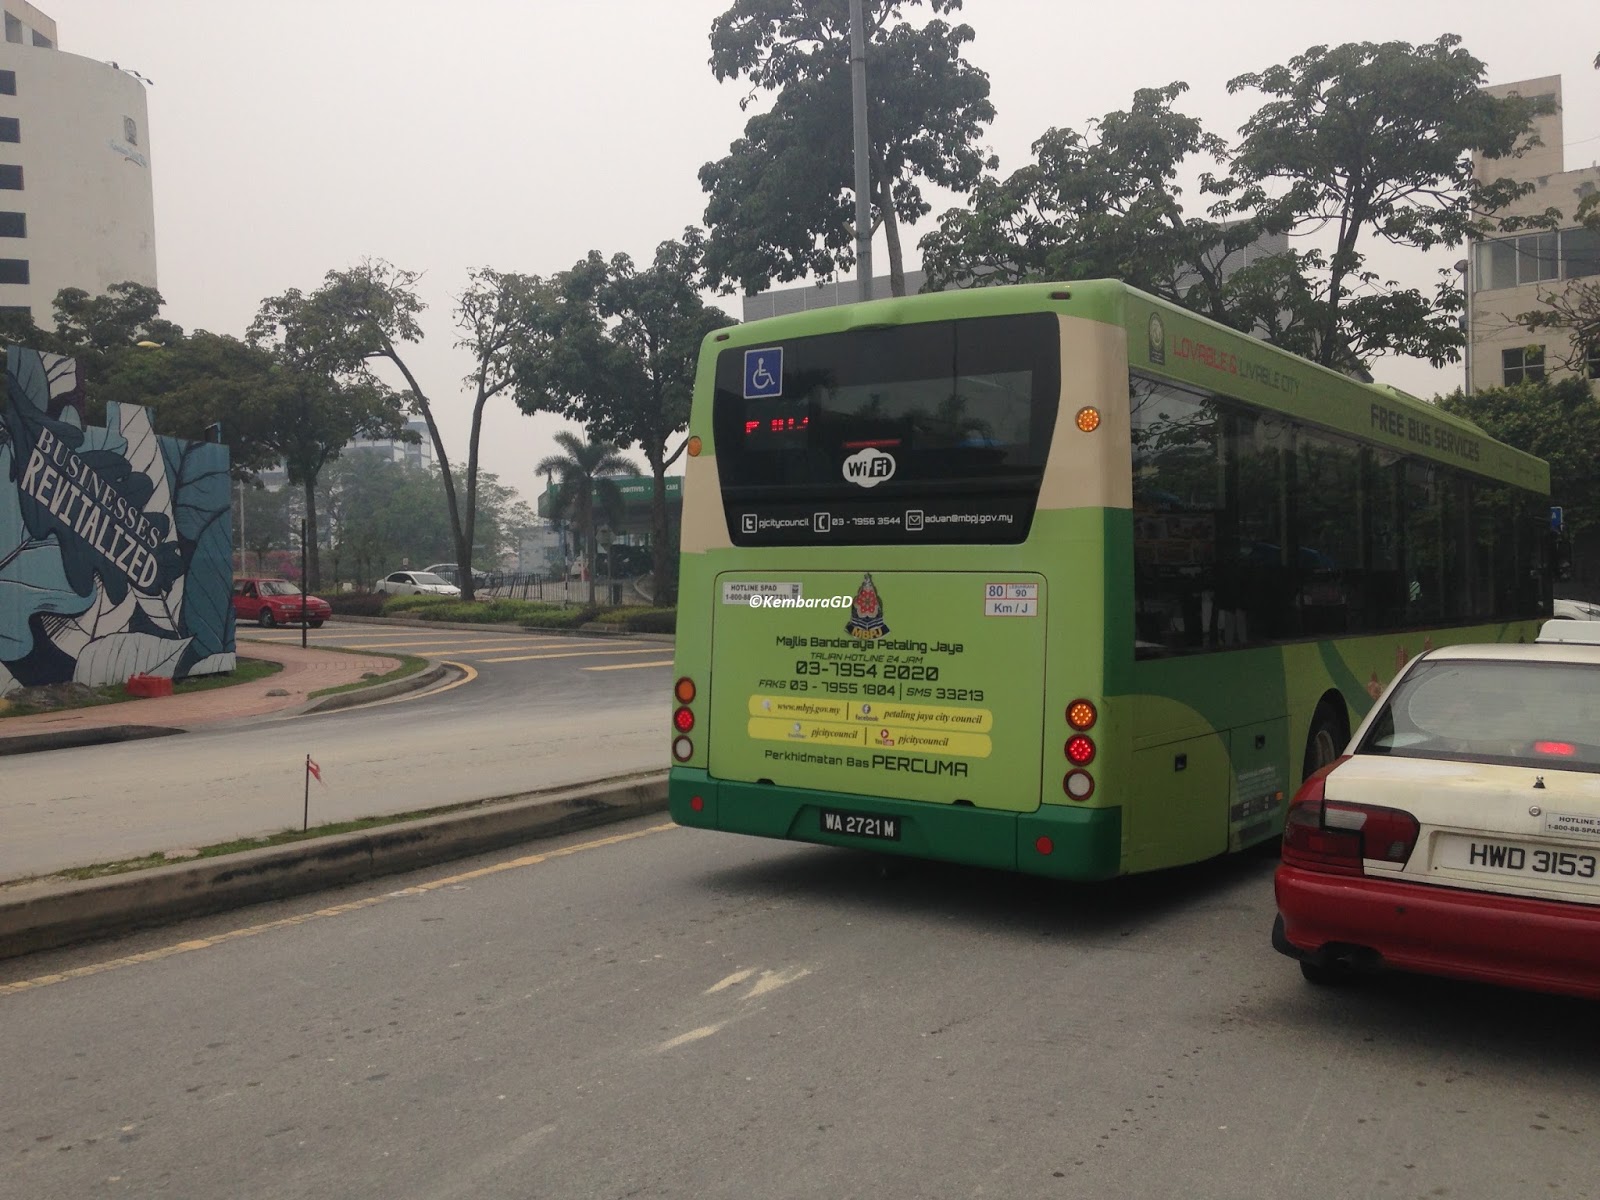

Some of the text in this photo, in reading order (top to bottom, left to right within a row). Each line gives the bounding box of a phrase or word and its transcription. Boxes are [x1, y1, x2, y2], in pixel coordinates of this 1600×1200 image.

[1371, 403, 1480, 462] FREE BUS SERVICES
[35, 426, 160, 549] BUSINESSES
[20, 448, 158, 589] REVITALIZED
[759, 518, 809, 528] pjcitycouncil
[832, 518, 844, 526] 03
[852, 517, 876, 525] 7956
[877, 517, 901, 525] 3544
[925, 514, 1013, 524] aduan@mbpj.gov.my
[989, 585, 1004, 597] 80
[1015, 589, 1027, 597] 90
[994, 603, 1012, 613] Km
[1021, 603, 1028, 613] J
[852, 627, 882, 639] MBPJ
[776, 636, 963, 655] Majlis Bandaraya Petaling Jaya
[811, 652, 923, 664] TALIAN HOTLINE 24 JAM
[796, 660, 938, 681] 03-7954 2020
[759, 680, 787, 689] FAKS
[790, 680, 808, 691] 03
[821, 682, 858, 693] 7955
[863, 684, 895, 696] 1804
[906, 687, 984, 701] SMS 33213
[777, 703, 840, 715] www.mbpj.gov.my
[884, 709, 982, 724] petaling jaya city council
[811, 728, 858, 739] pjcitycouncil
[897, 734, 949, 747] pjcitycouncil
[765, 749, 968, 777] Perkhidmatan Bas PERCUMA
[825, 813, 894, 837] WA 2721 M
[1559, 816, 1594, 825] HOTLINE
[1470, 843, 1597, 878] HWD 3153
